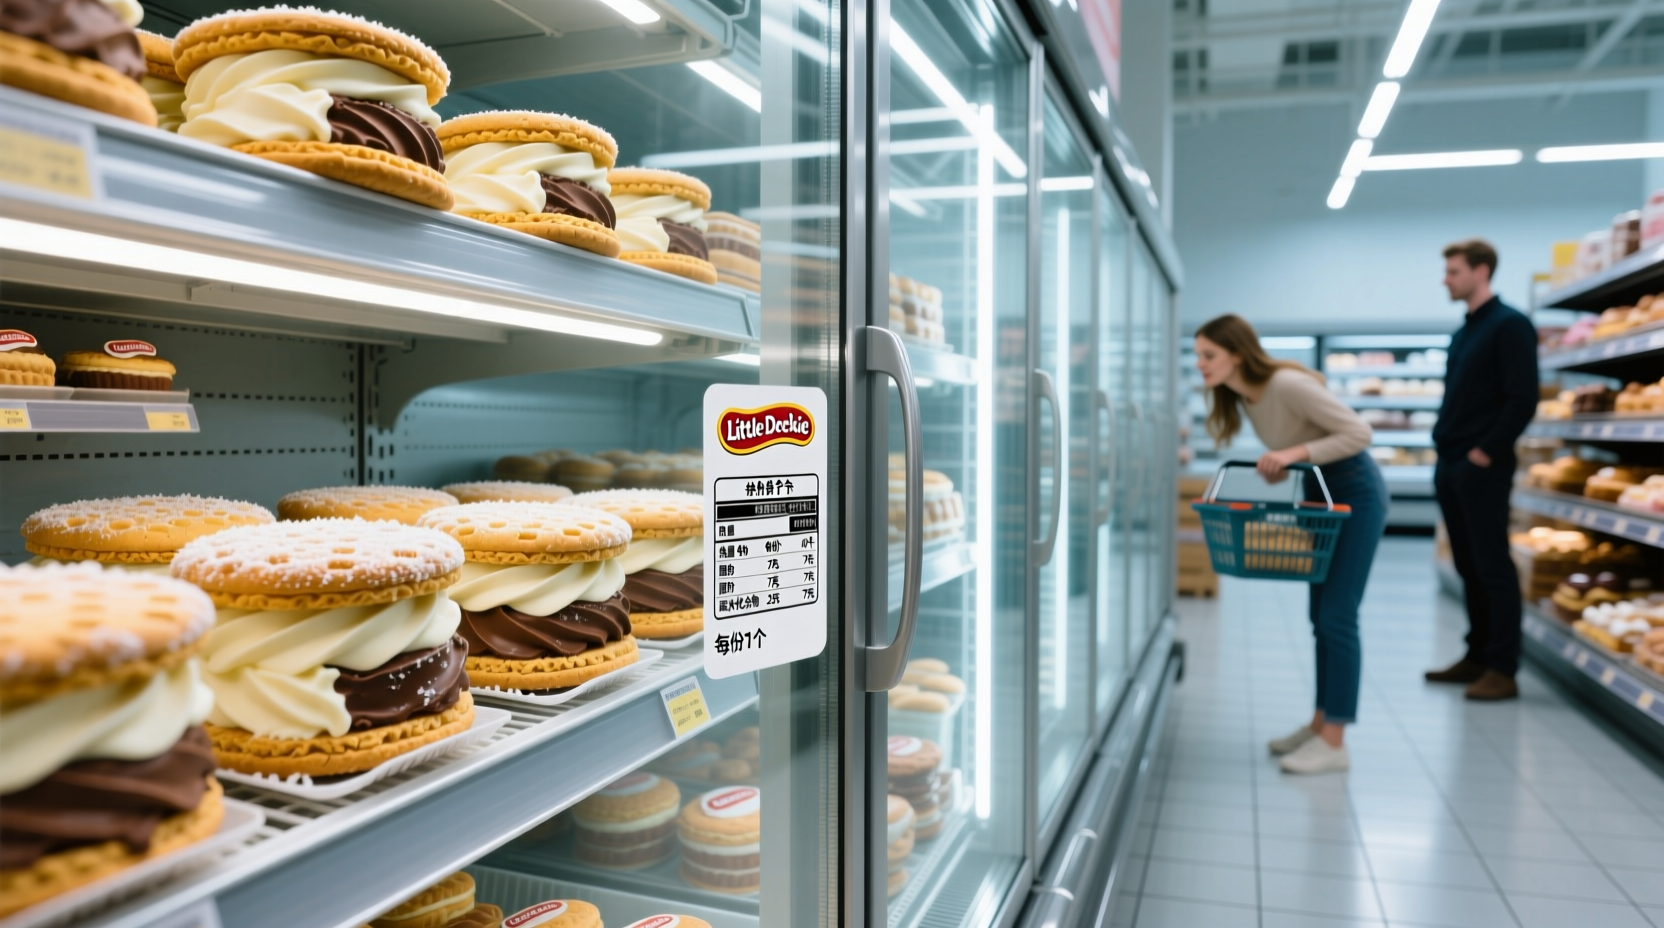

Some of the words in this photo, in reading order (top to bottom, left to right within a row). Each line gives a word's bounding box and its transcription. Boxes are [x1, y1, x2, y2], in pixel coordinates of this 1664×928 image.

[727, 416, 764, 440] Little
[714, 628, 767, 655] 每份1个
